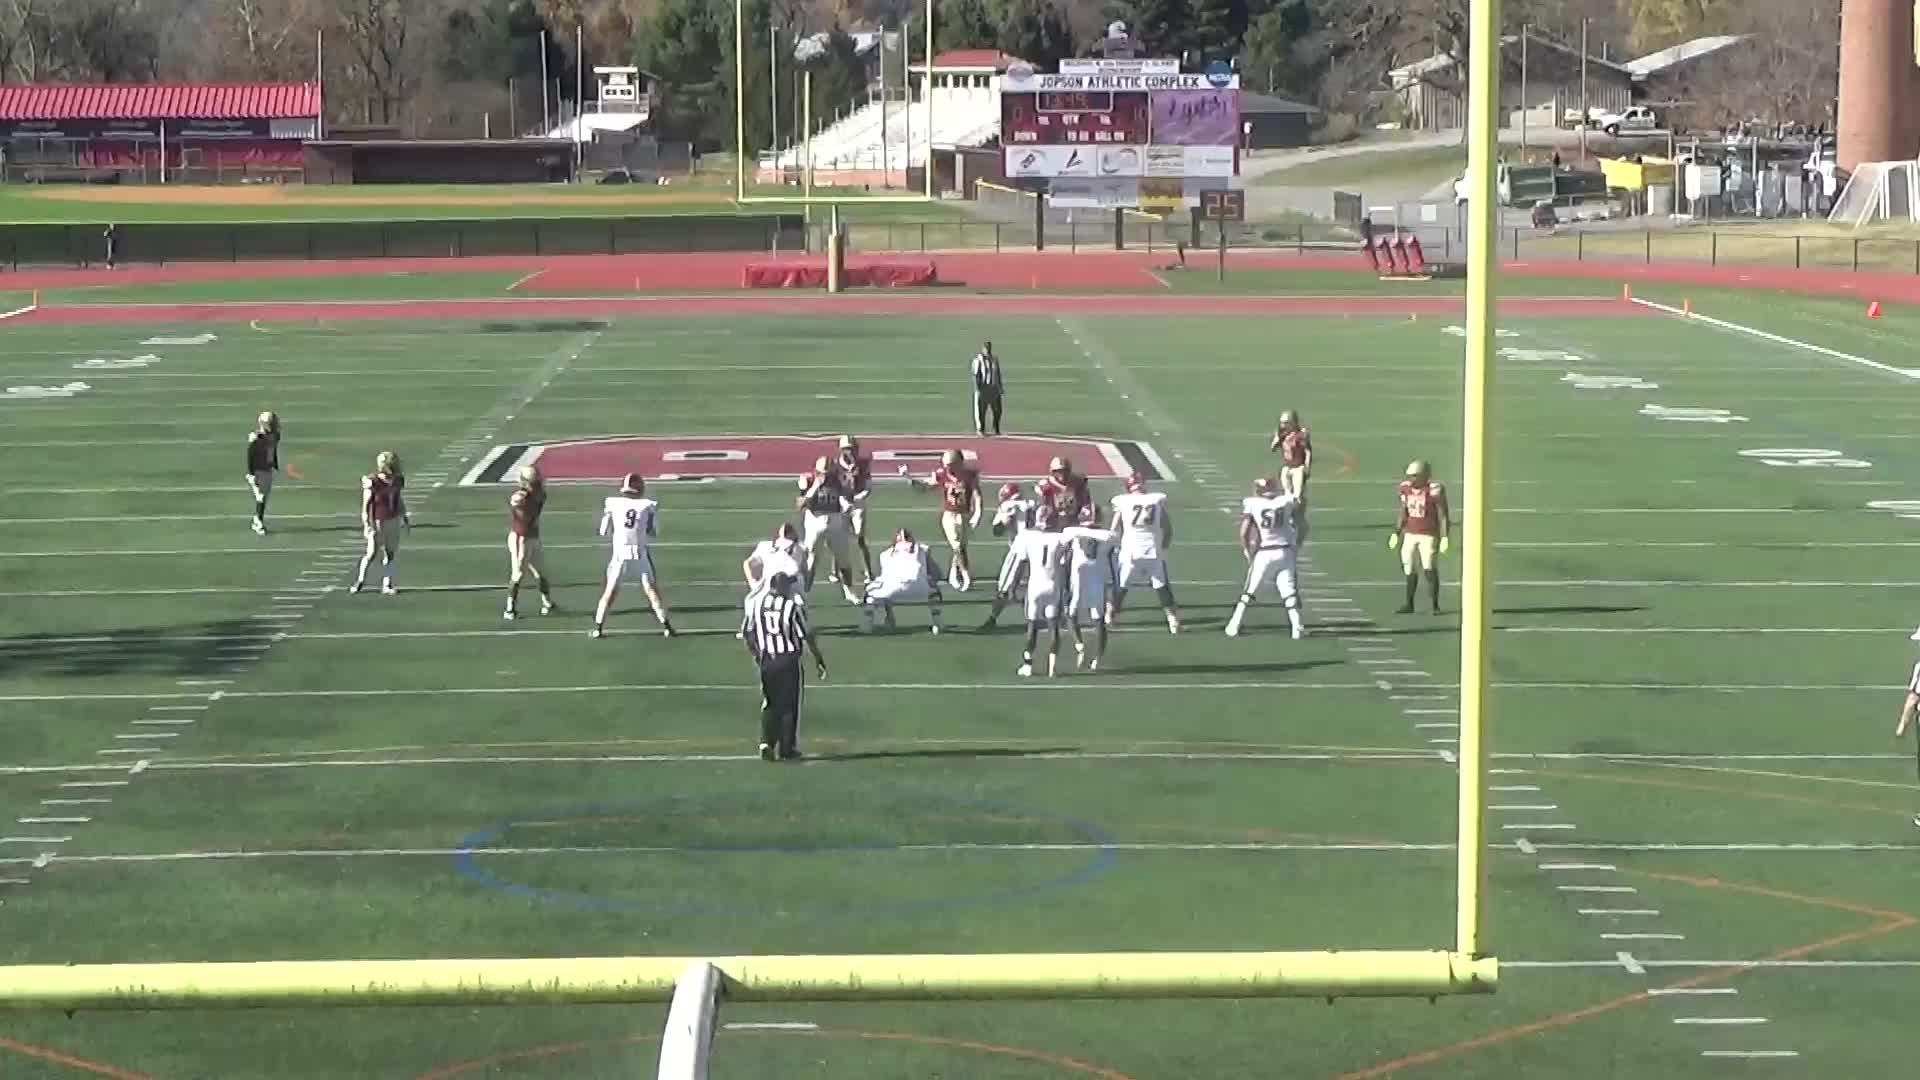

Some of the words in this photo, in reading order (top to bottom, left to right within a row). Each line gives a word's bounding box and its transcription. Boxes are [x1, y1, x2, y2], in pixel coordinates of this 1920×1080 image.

[1040, 76, 1083, 89] JOPSON
[1088, 76, 1142, 89] ATHLETIC
[1145, 76, 1199, 89] COMPLEX
[1207, 193, 1240, 217] 25
[624, 508, 637, 529] 9
[1042, 544, 1049, 567] 1
